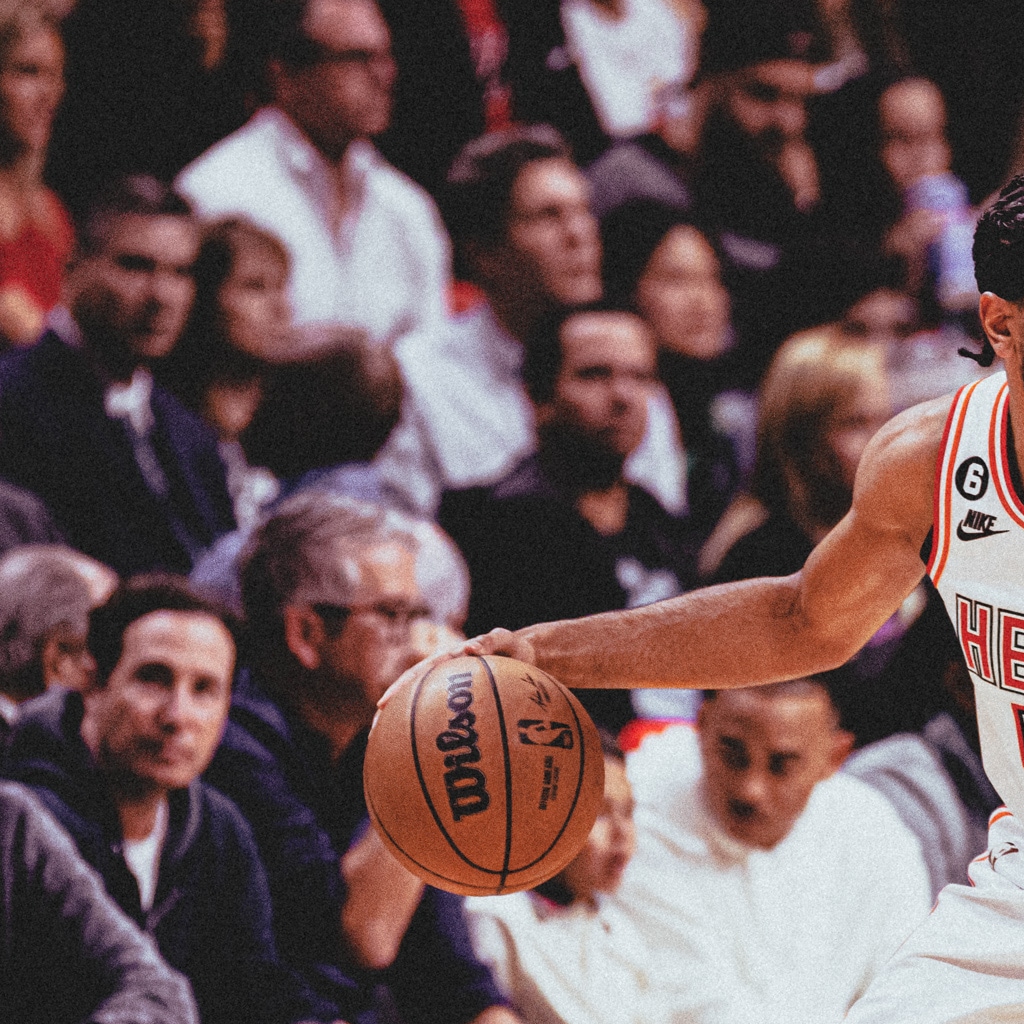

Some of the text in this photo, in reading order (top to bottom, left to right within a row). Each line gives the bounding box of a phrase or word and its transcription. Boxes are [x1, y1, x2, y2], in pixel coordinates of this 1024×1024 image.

[962, 462, 984, 496] 6
[963, 508, 998, 532] NIKE
[436, 672, 490, 823] Wilson
